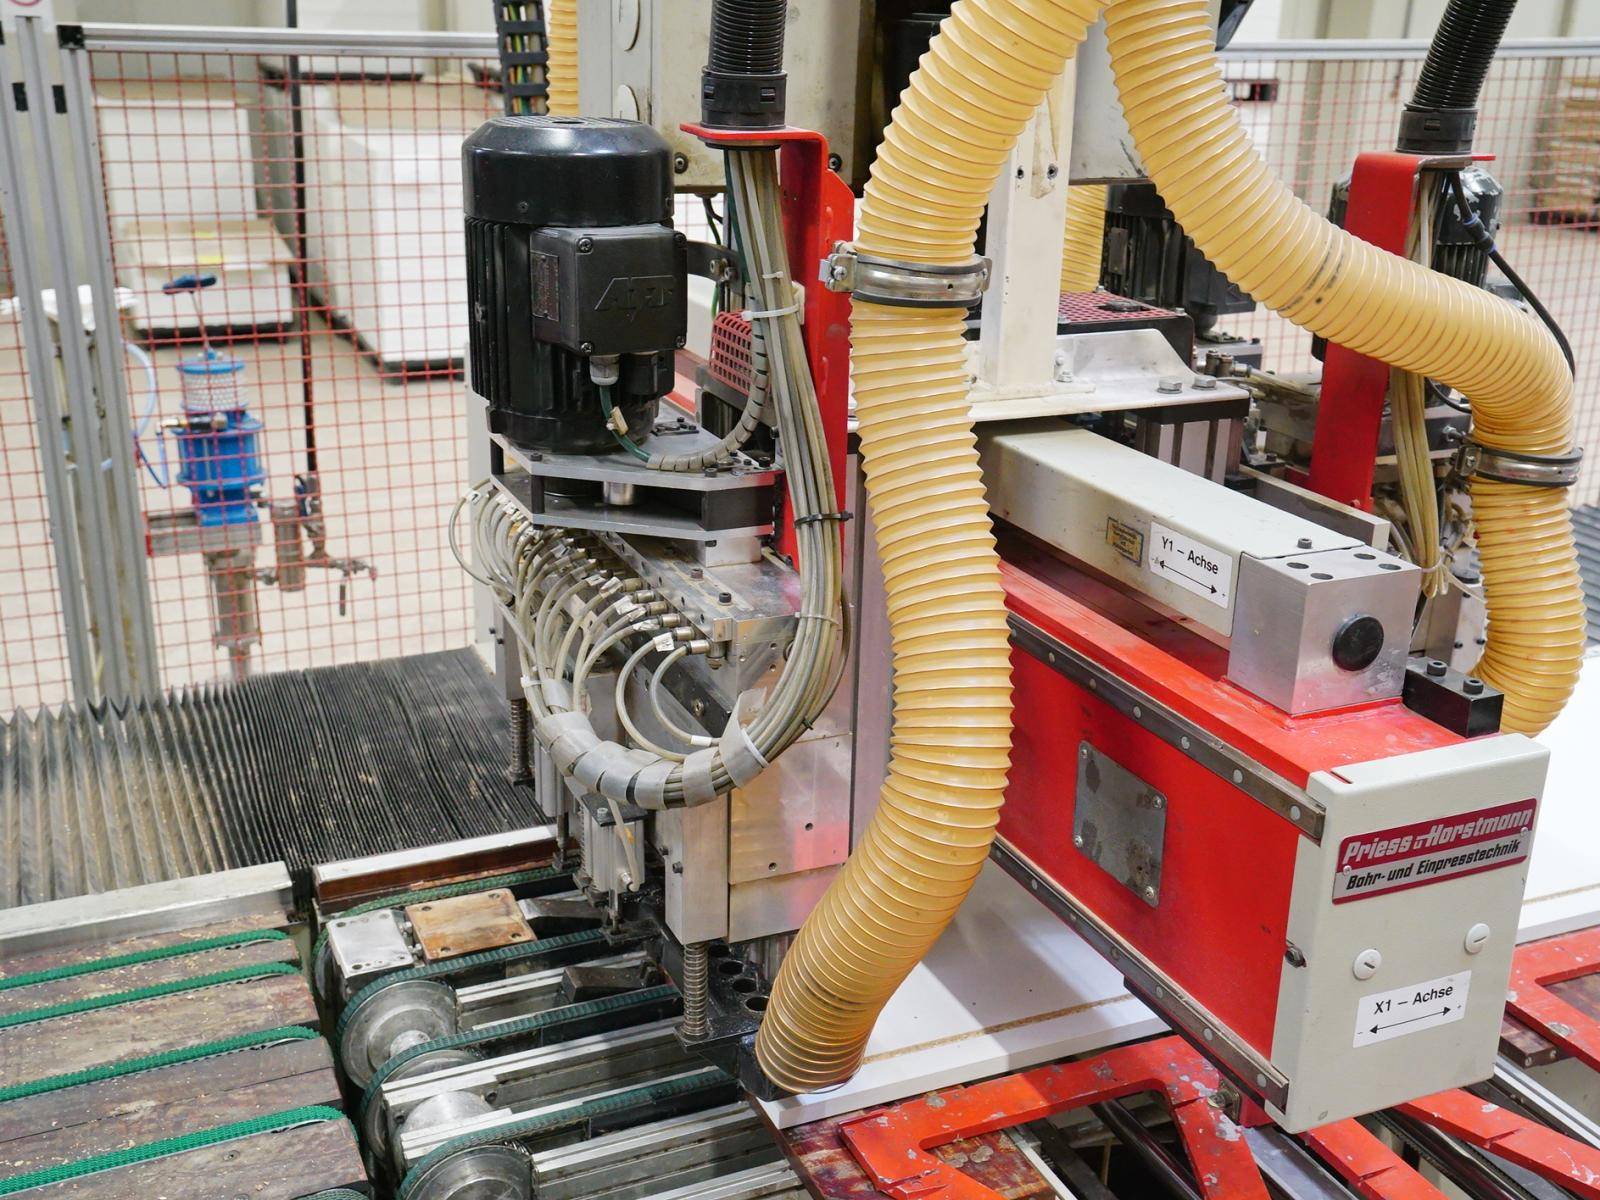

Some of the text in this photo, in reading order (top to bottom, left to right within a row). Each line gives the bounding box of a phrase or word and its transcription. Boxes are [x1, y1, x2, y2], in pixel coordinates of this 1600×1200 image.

[1162, 536, 1173, 551] Y1
[1187, 550, 1219, 574] Achse
[1342, 836, 1412, 865] Priess
[1424, 809, 1533, 847] Horstmann
[1346, 839, 1521, 890] Bohr- und Einpresstechnik
[1374, 999, 1392, 1015] X1
[1413, 985, 1454, 1005] Achse
